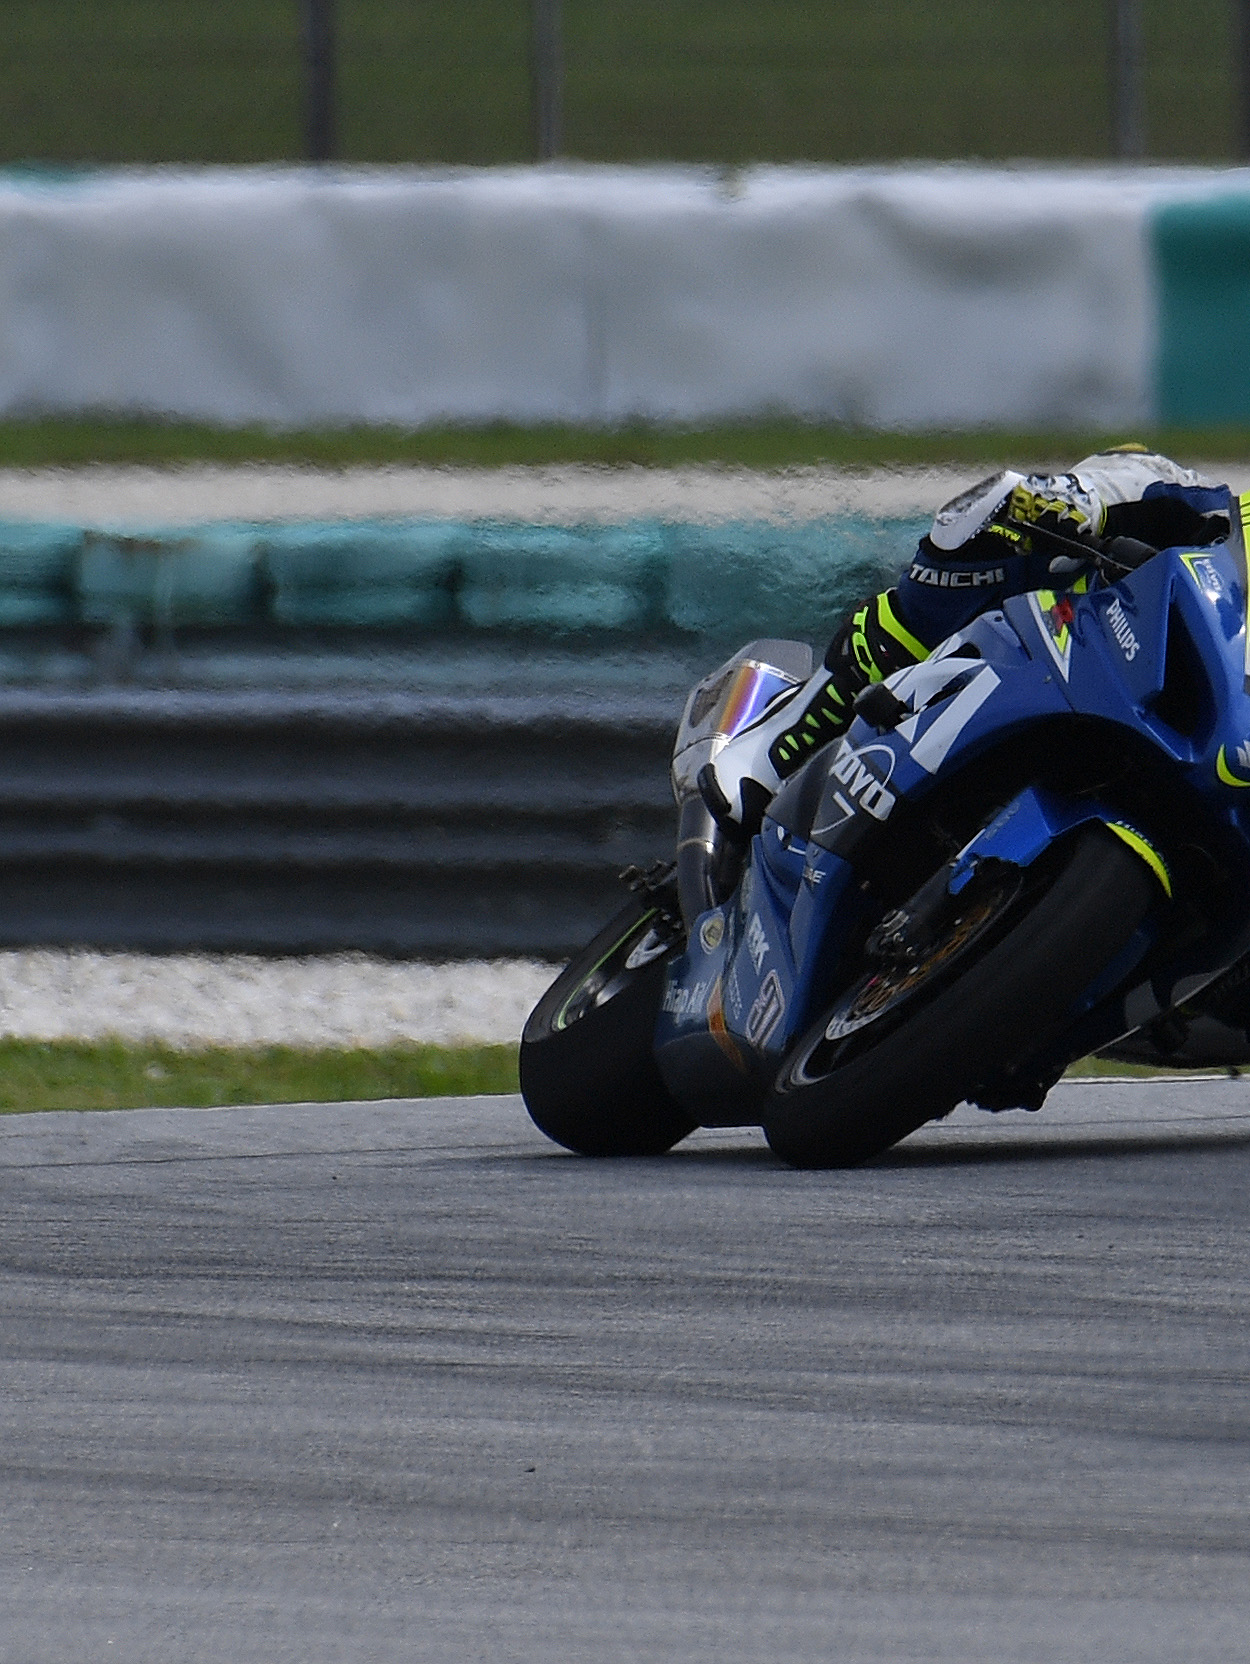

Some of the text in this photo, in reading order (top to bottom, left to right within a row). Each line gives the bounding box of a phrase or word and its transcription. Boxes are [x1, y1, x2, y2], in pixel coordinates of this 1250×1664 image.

[910, 563, 1004, 587] TAICHI
[1106, 598, 1140, 662] PHILIPS
[828, 739, 896, 821] TOYO
